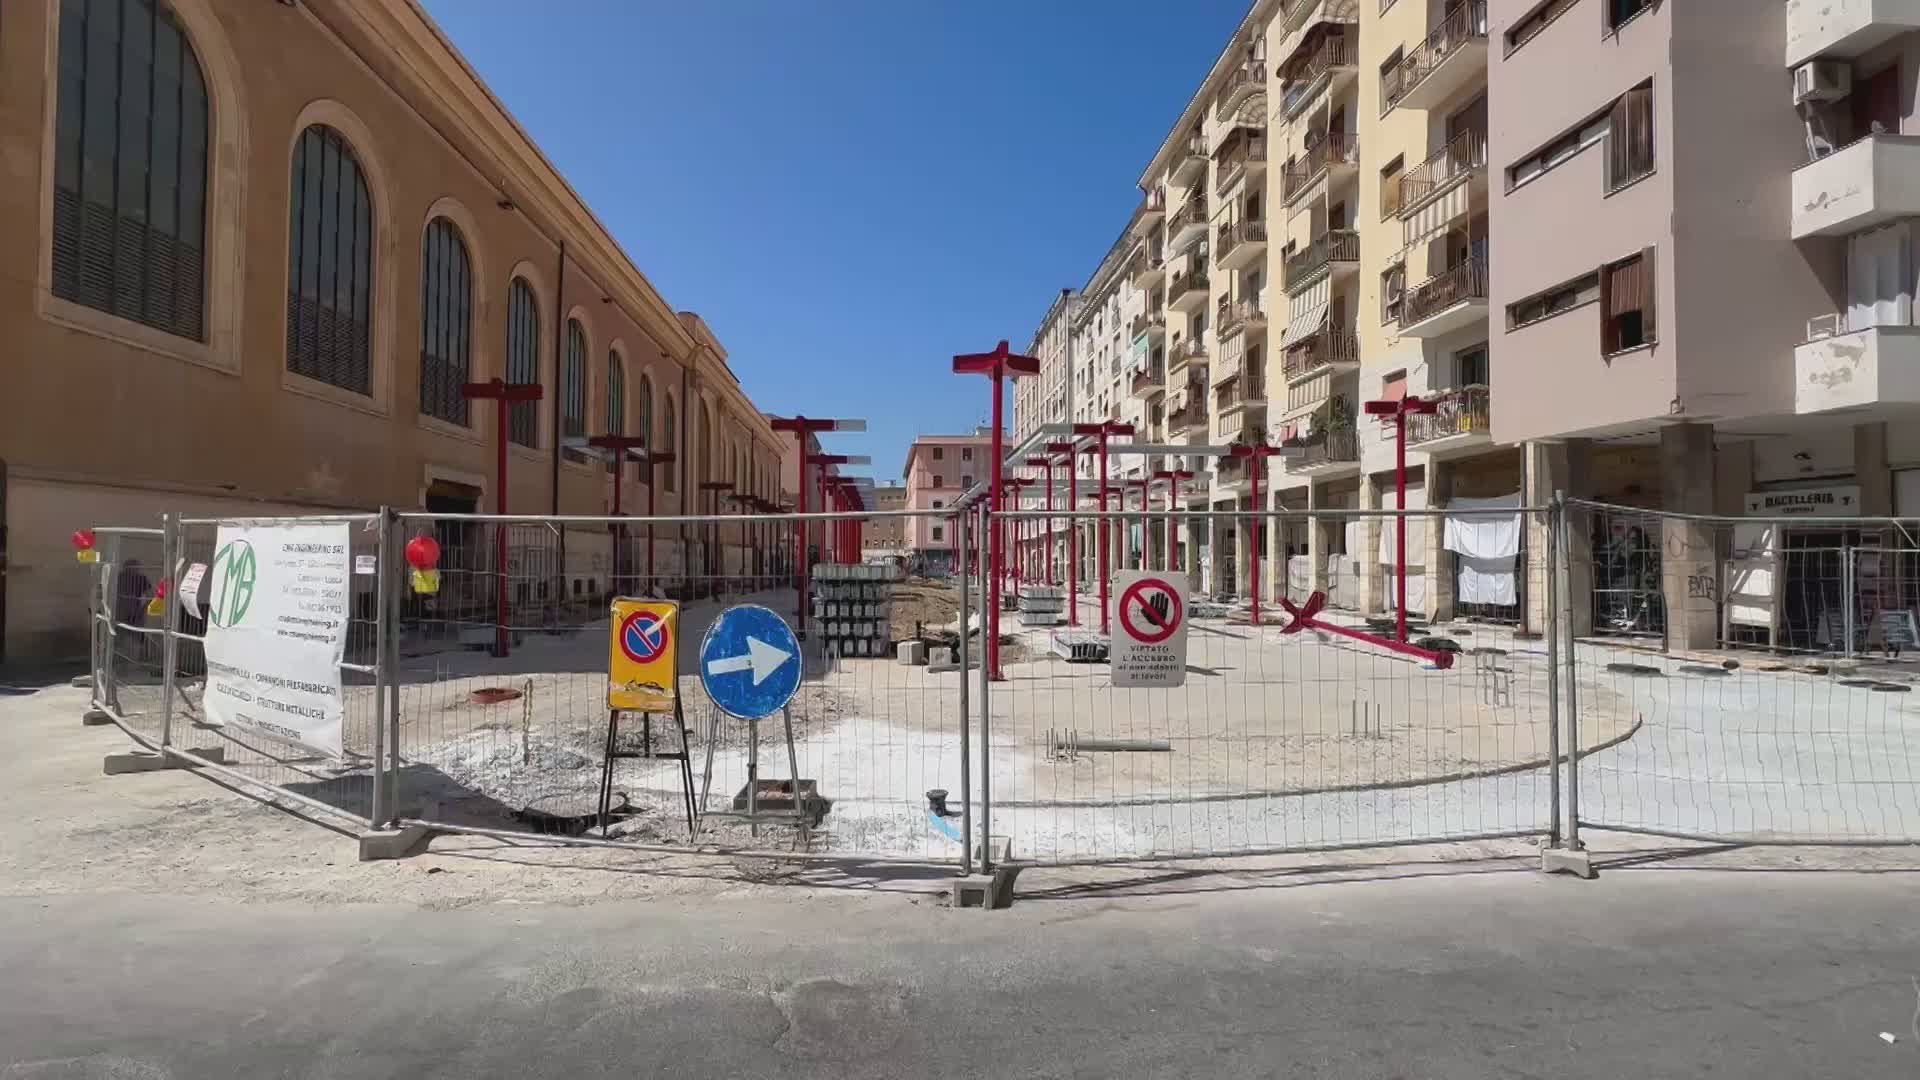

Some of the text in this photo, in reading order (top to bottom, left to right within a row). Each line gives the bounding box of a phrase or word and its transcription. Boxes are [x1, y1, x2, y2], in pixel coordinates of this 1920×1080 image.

[1764, 492, 1835, 509] MACELLERIA
[332, 545, 344, 554] SRL
[1130, 645, 1169, 653] VIETATO
[1122, 654, 1177, 662] L'ACCESSO
